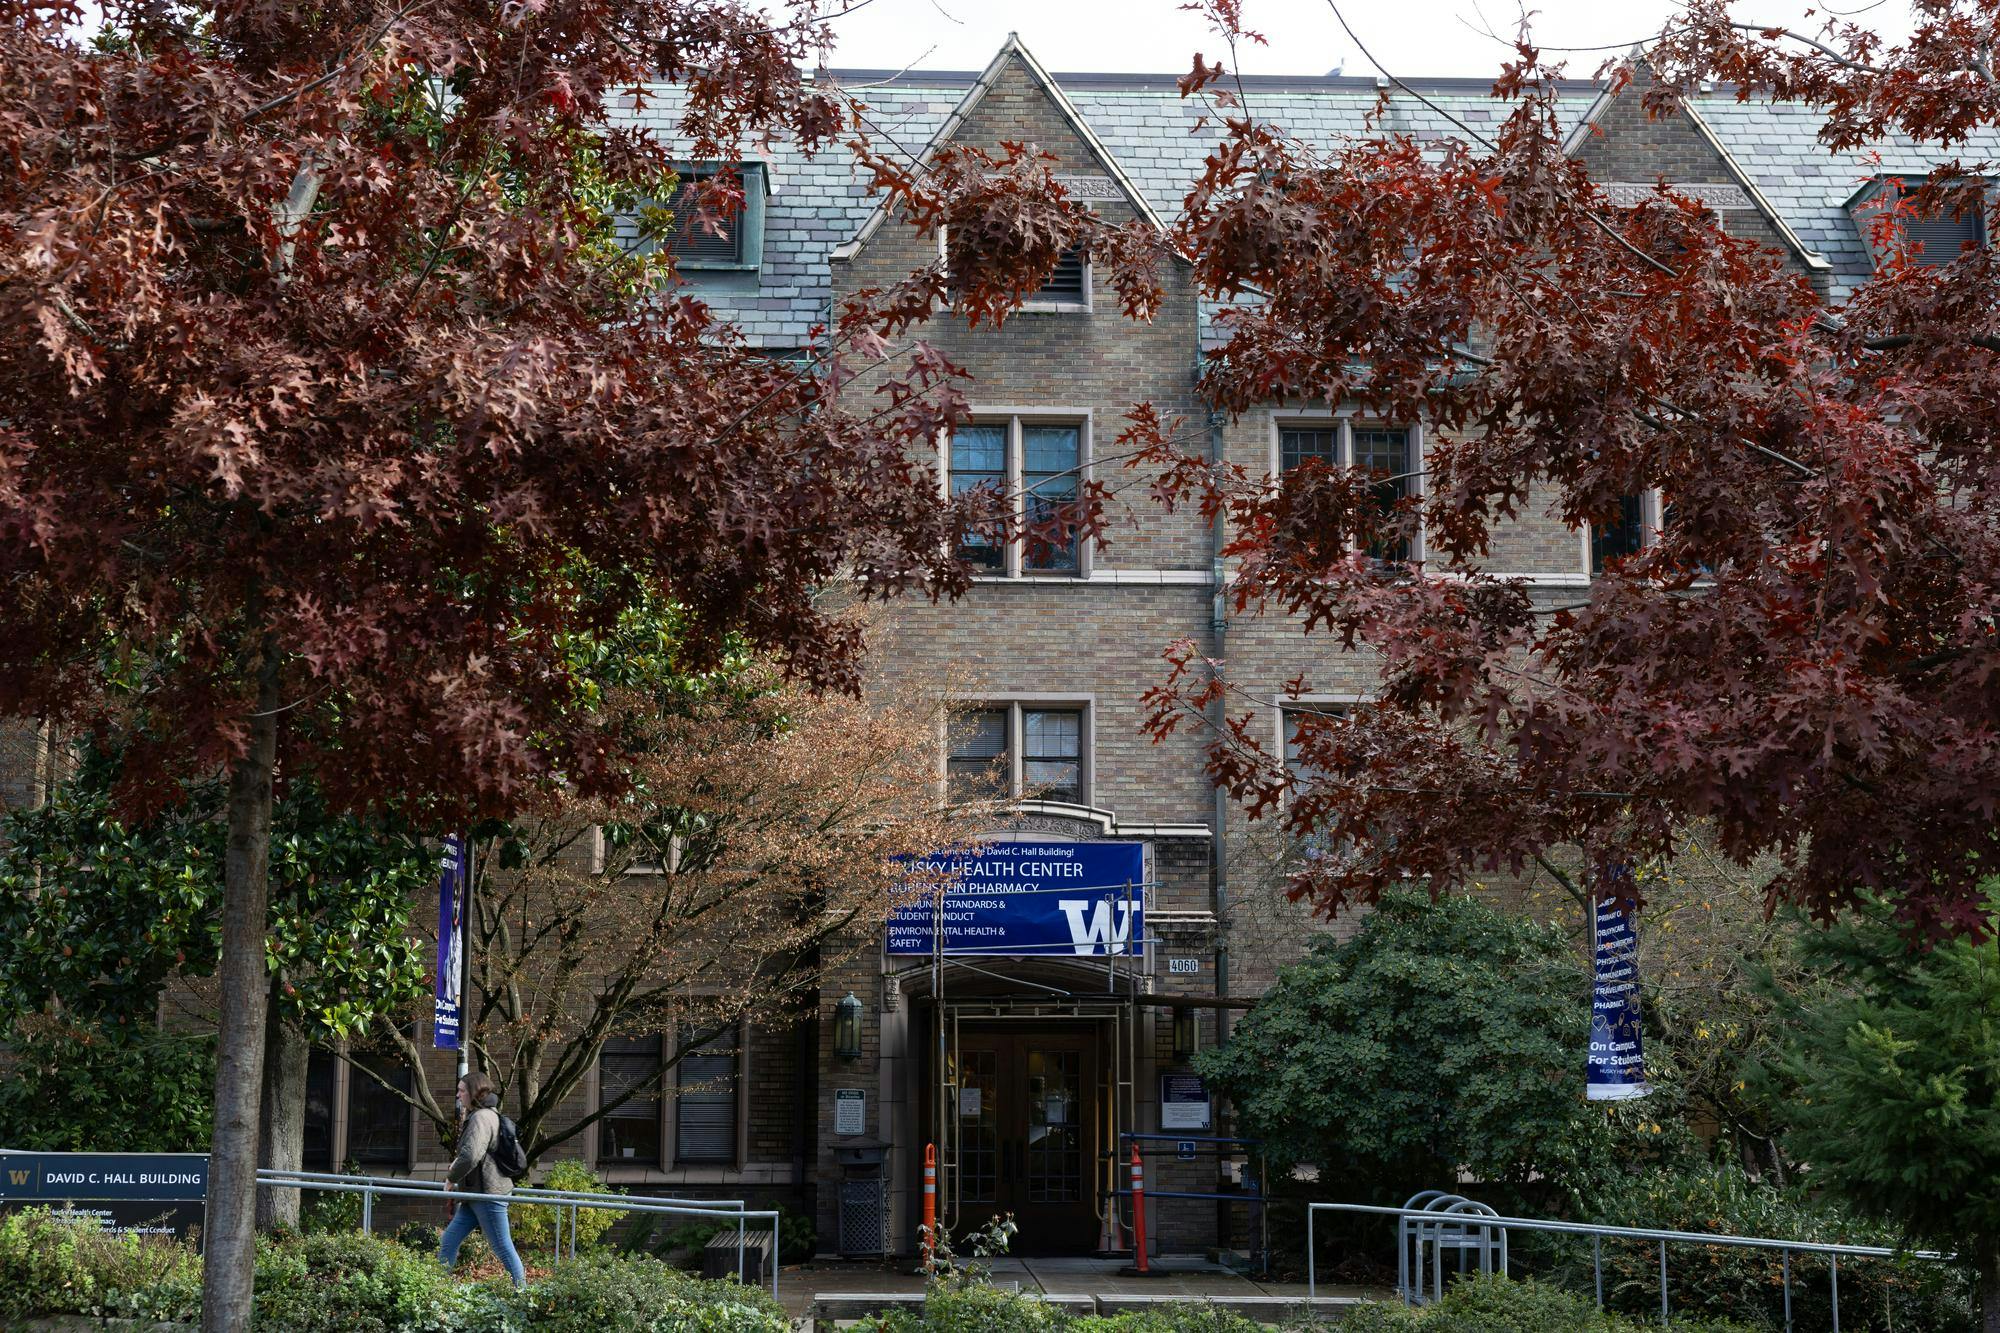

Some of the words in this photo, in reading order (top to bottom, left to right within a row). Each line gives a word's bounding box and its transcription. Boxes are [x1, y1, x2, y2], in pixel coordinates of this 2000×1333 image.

[987, 847, 1010, 856] David
[1012, 848, 1020, 856] C.
[1021, 847, 1037, 856] Hall
[1039, 848, 1074, 858] Building!
[903, 861, 946, 875] USKY
[951, 862, 1014, 877] HEALTH
[1019, 862, 1083, 877] CENTER
[969, 883, 1039, 894] PHARMACY
[946, 900, 998, 909] STANDARDS
[999, 901, 1006, 909] &
[964, 927, 997, 936] HEALTH
[999, 927, 1006, 936] &
[1059, 900, 1140, 955] W
[890, 939, 922, 948] SAFETY
[1172, 960, 1197, 971] 4060
[1590, 1042, 1606, 1051] On
[1589, 1055, 1608, 1065] For
[8, 1170, 30, 1185] W
[46, 1173, 85, 1184] DAVID
[88, 1173, 100, 1184] C.
[104, 1174, 135, 1184] HALL
[140, 1174, 201, 1185] BUILDING
[91, 1209, 113, 1217] Center
